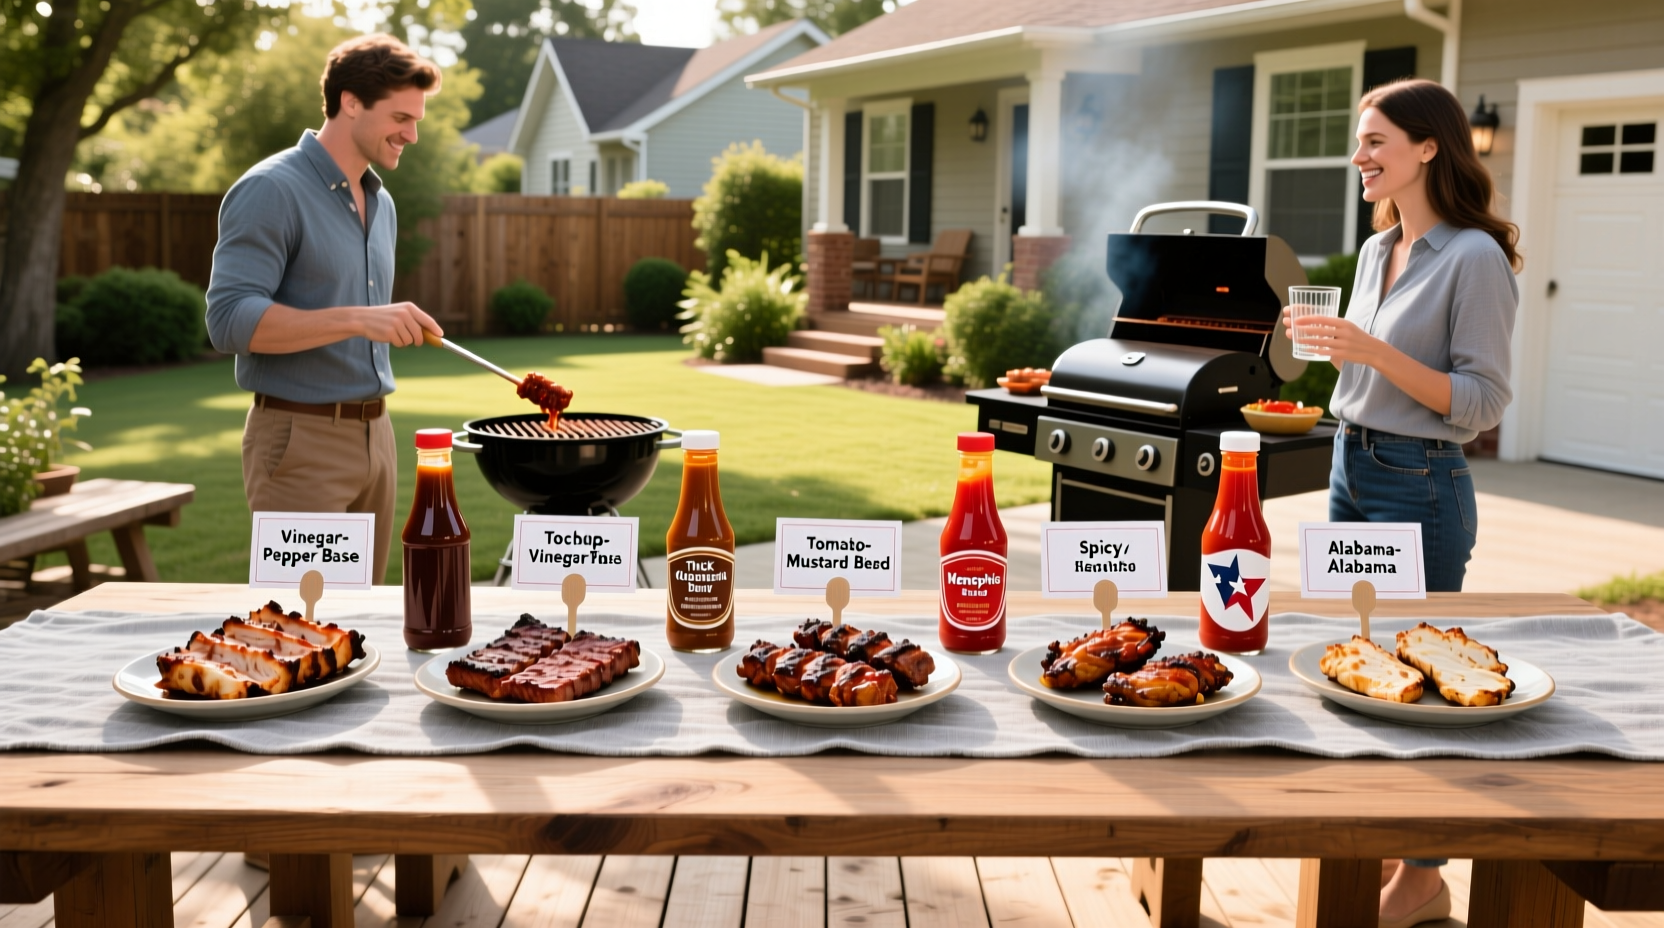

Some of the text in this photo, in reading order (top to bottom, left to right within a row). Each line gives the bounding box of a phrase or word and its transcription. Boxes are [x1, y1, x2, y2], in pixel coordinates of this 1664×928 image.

[281, 529, 349, 549] Vinegar-
[806, 536, 871, 551] Tomato-
[1328, 540, 1401, 556] Alabama-
[263, 547, 360, 567] Pepper Base
[529, 549, 589, 568] Vinegar
[786, 554, 849, 569] Mustard
[1327, 558, 1397, 574] Alabama
